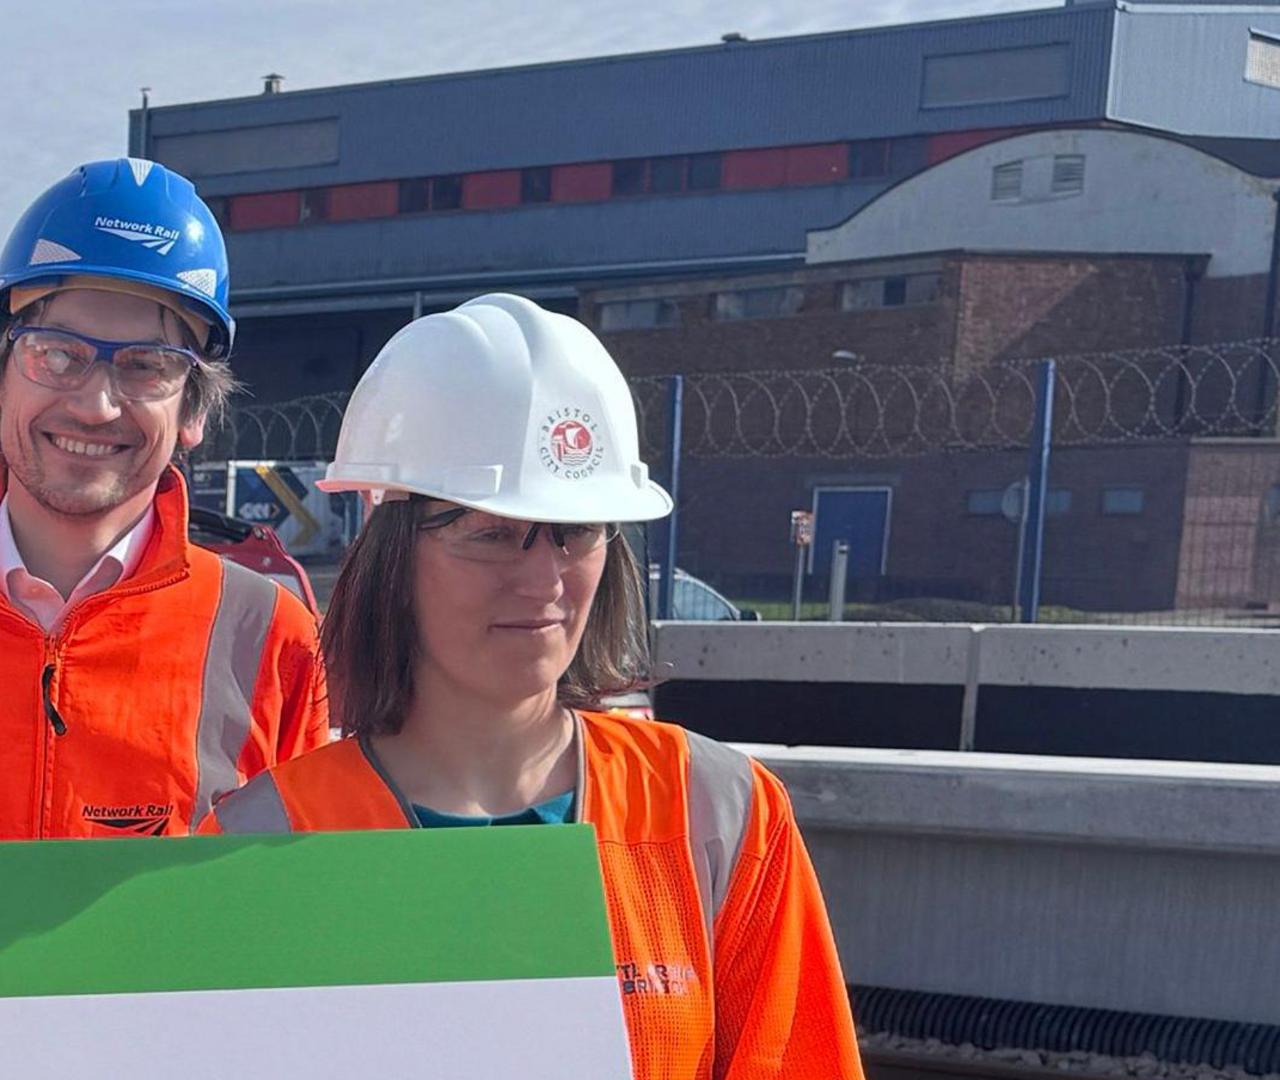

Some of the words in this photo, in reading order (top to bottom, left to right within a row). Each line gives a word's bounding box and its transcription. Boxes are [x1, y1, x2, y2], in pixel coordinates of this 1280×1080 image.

[94, 217, 153, 234] Network
[154, 226, 180, 240] Rail
[542, 407, 598, 433] BRISTOL
[82, 805, 143, 817] Network
[145, 804, 174, 816] Rail
